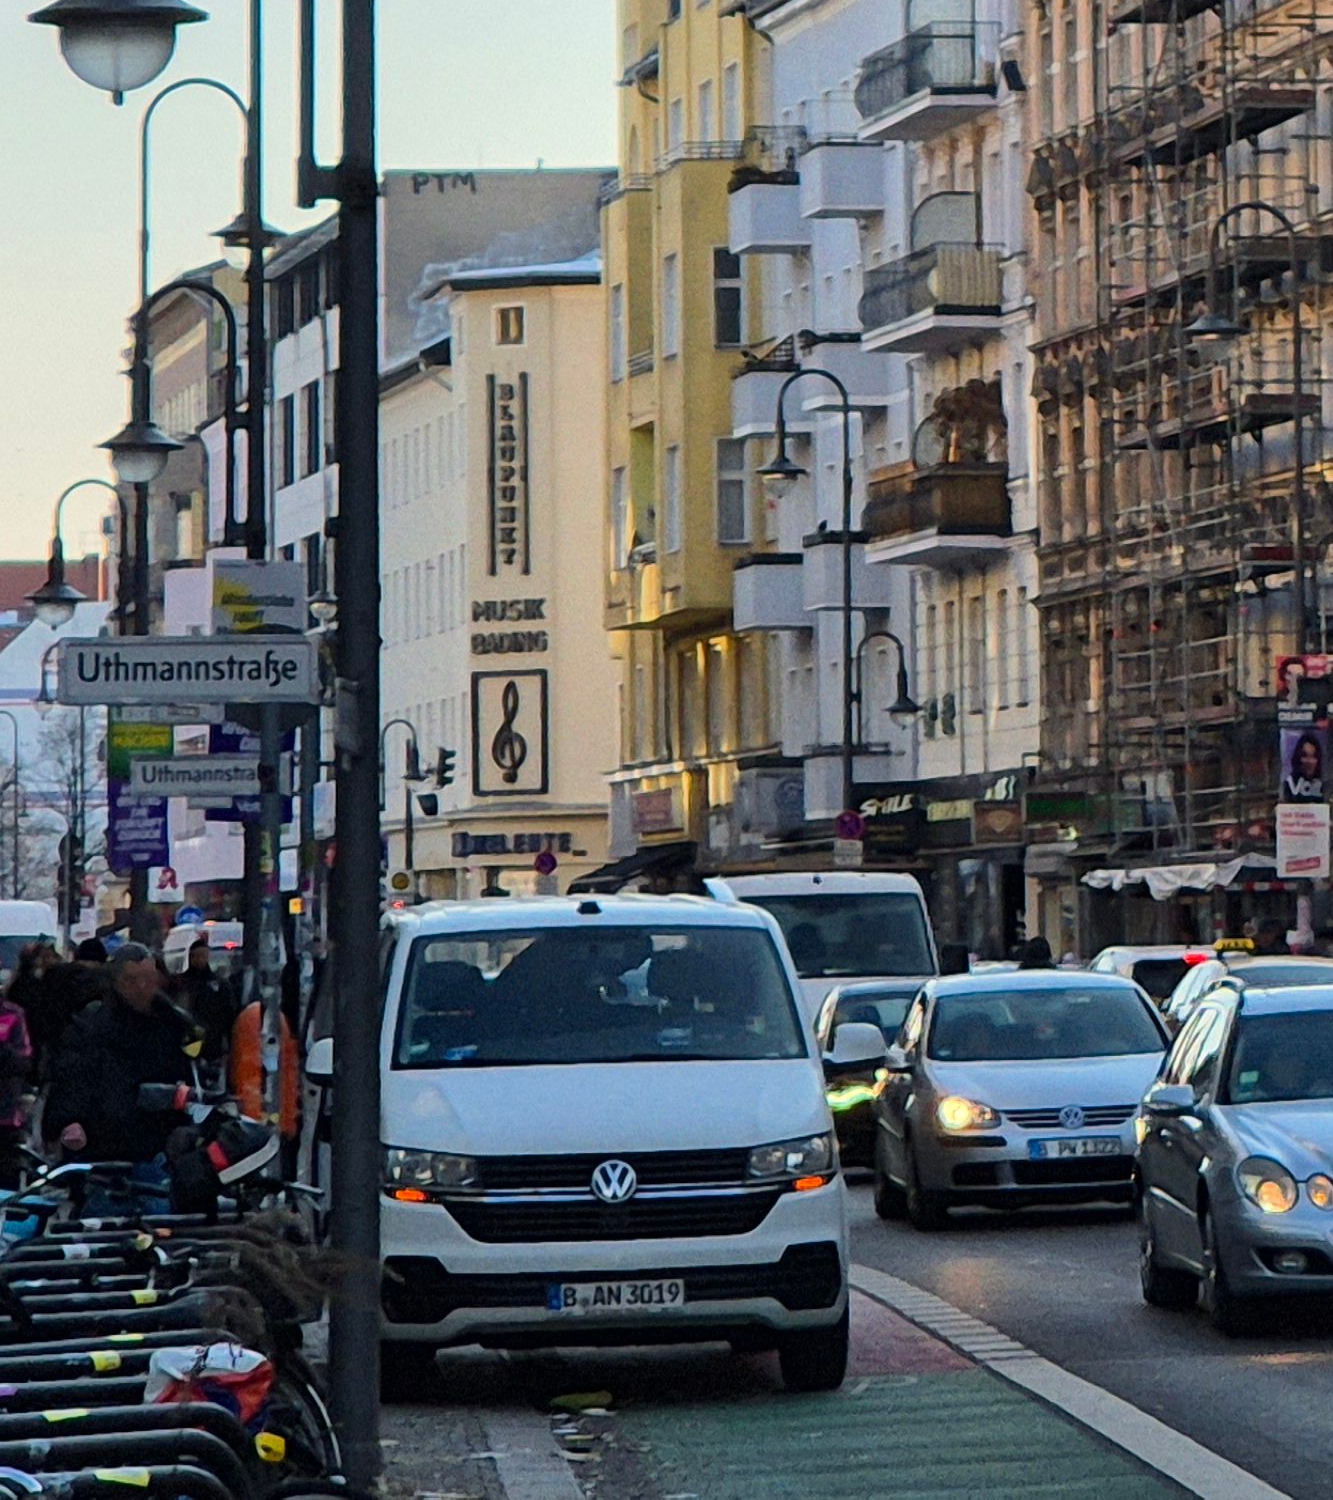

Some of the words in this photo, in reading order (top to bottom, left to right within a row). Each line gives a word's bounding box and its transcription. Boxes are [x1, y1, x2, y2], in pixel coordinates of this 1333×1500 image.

[471, 598, 546, 622] MUSIK
[77, 650, 297, 687] Uthmannstraße
[141, 765, 255, 784] Uthmannstra
[563, 1286, 578, 1307] B
[593, 1285, 622, 1306] AN
[626, 1282, 681, 1305] 3019
